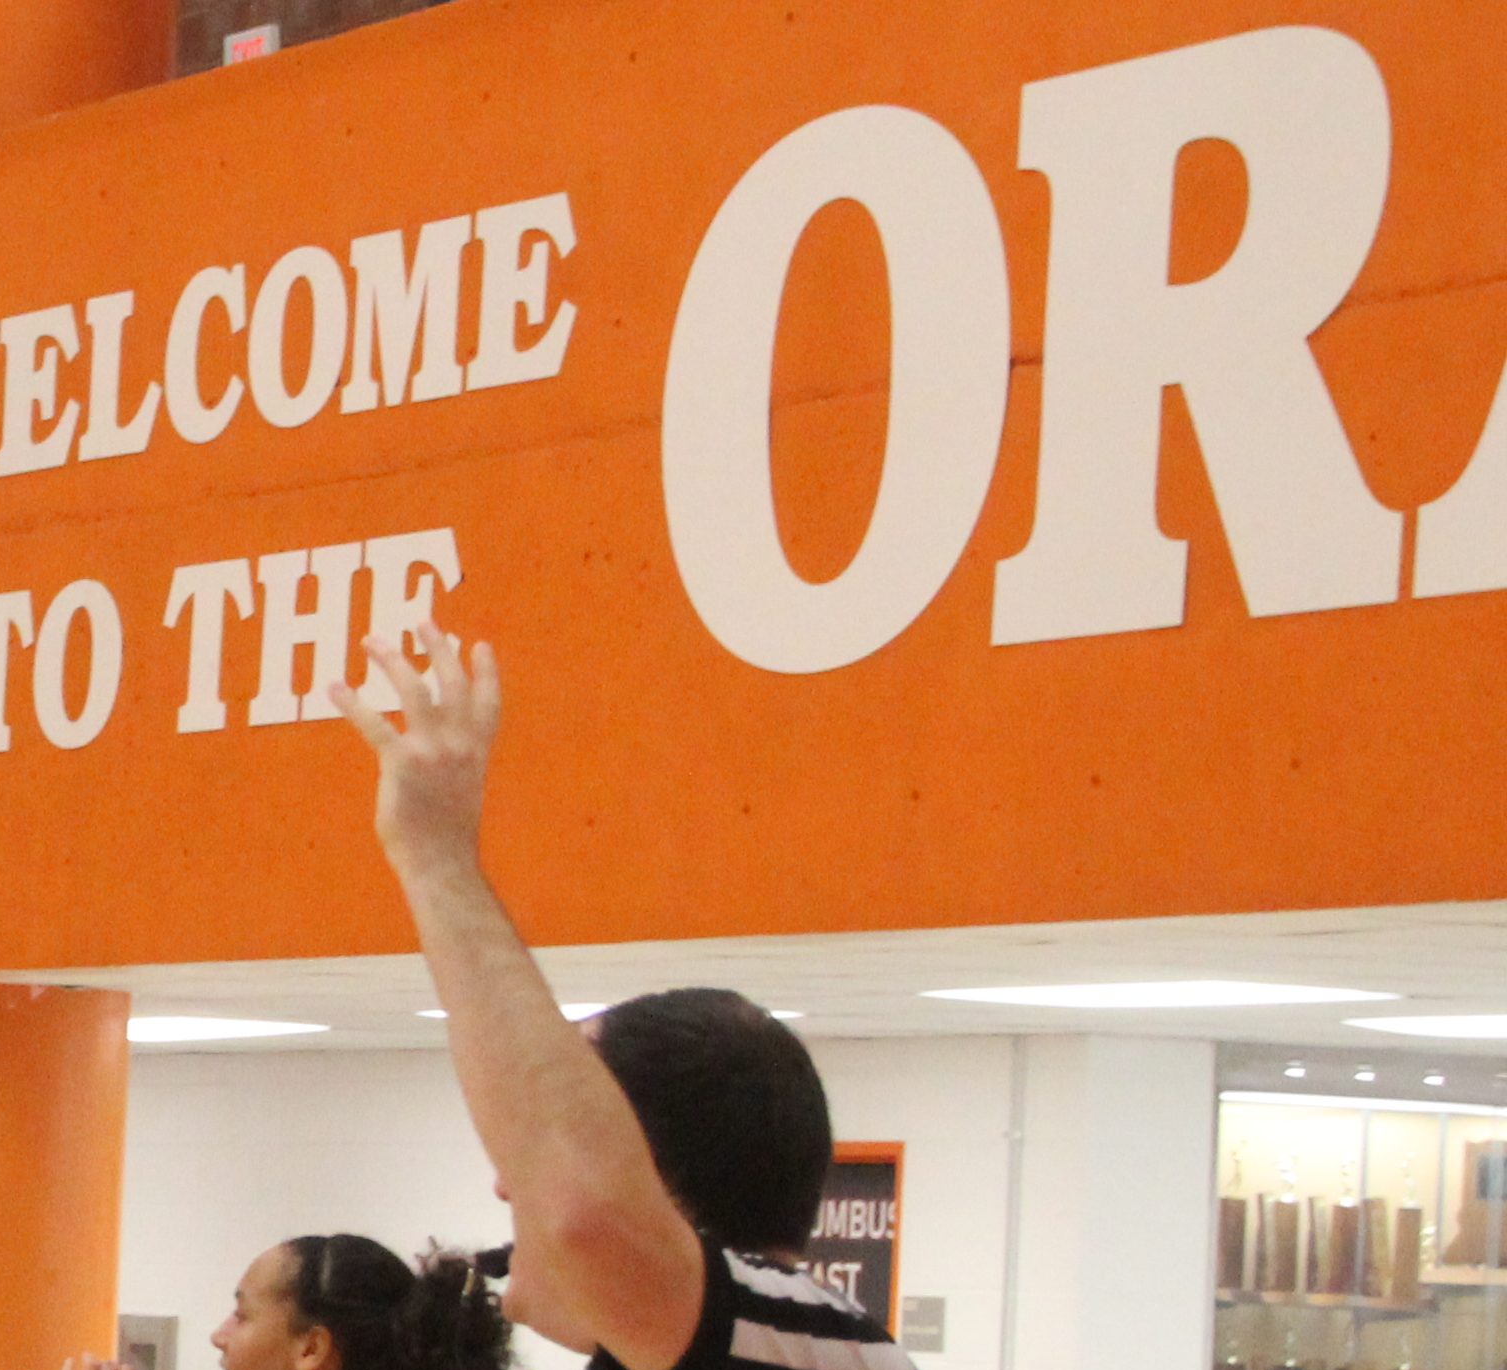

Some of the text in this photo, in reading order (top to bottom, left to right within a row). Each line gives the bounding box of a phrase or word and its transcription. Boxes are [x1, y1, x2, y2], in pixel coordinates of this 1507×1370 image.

[661, 26, 1507, 674] OR
[163, 527, 463, 734] THE
[795, 1262, 861, 1302] AST
